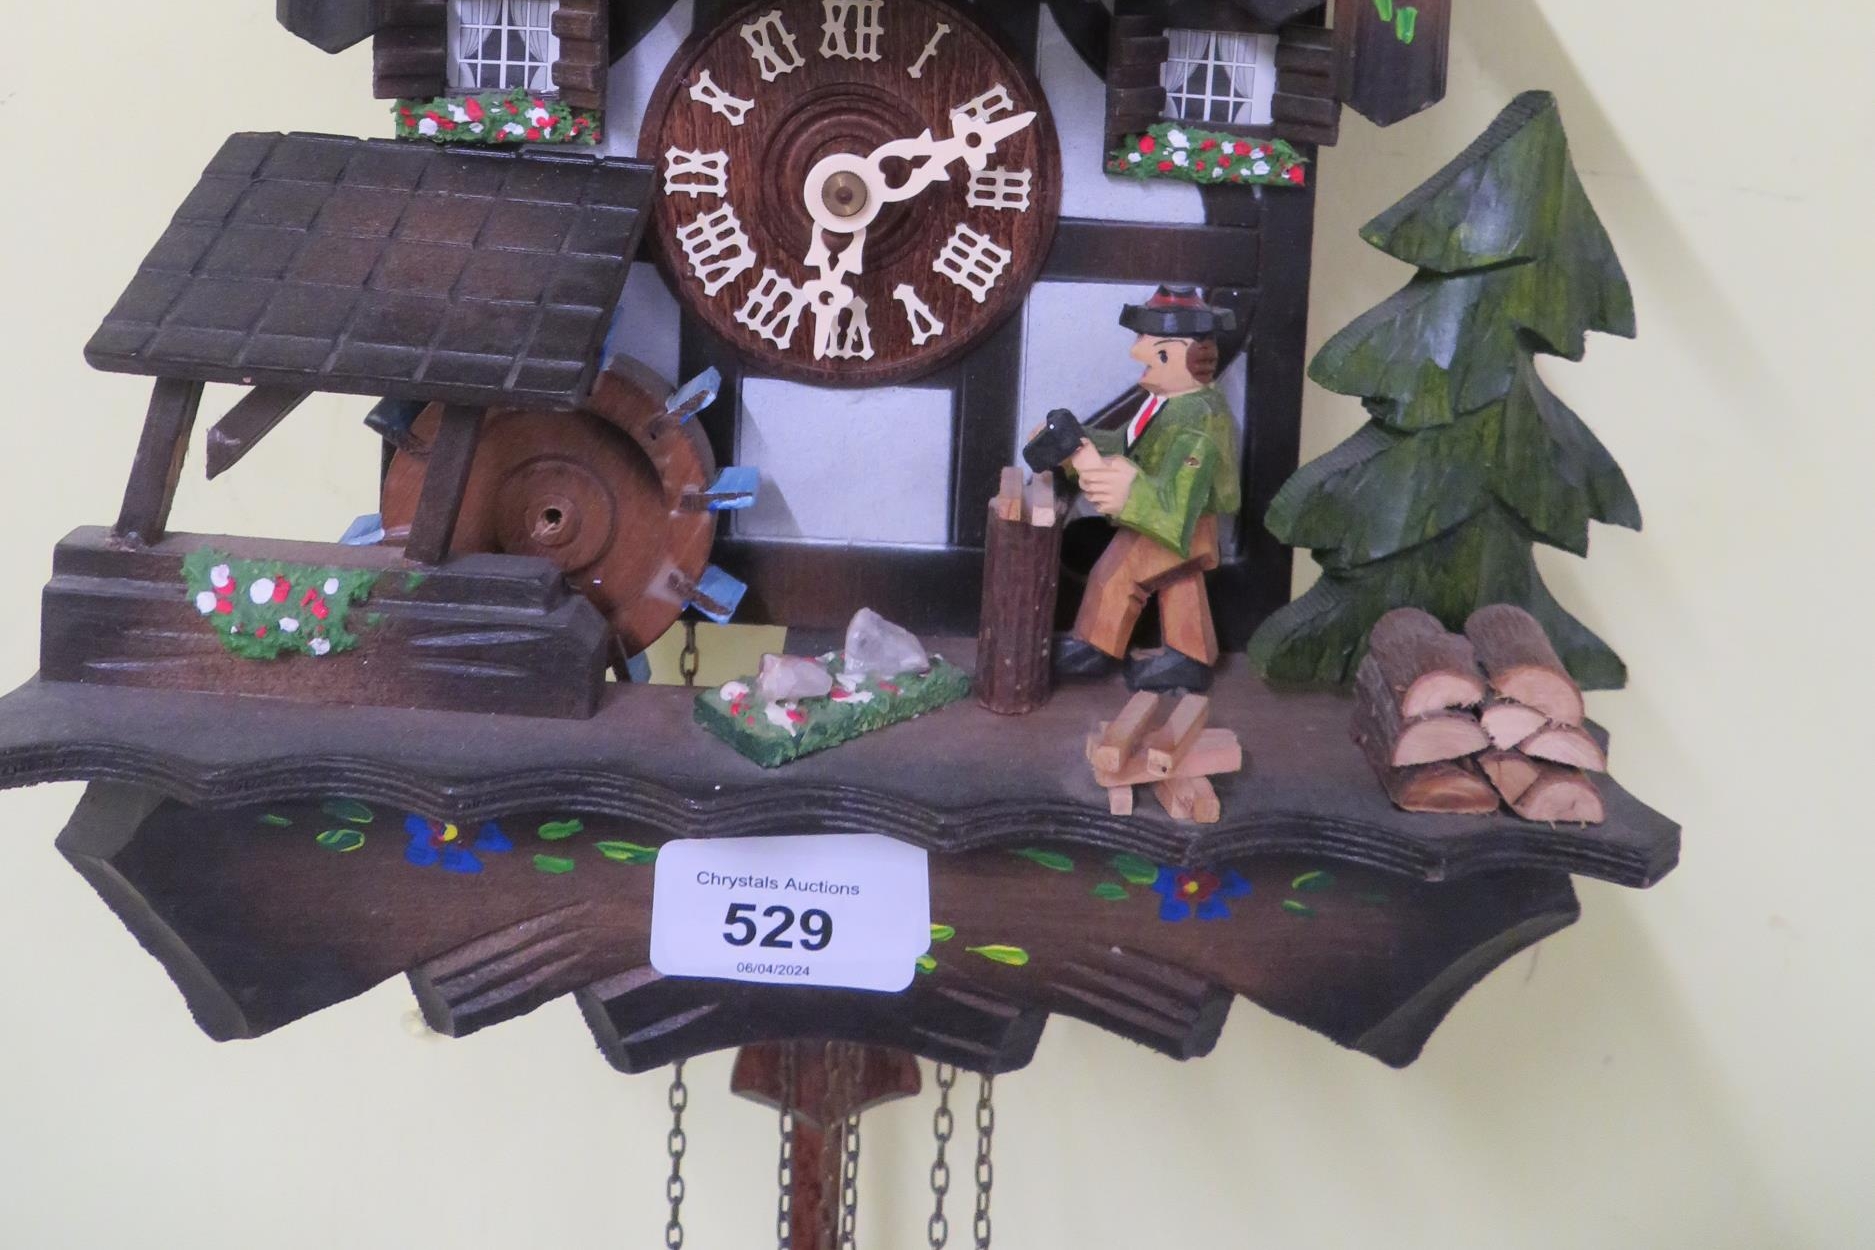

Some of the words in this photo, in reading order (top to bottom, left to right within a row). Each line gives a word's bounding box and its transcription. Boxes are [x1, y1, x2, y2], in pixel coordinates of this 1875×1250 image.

[696, 870, 779, 891] Chrystals
[784, 876, 860, 896] Auctions
[722, 902, 833, 951] 529
[736, 962, 810, 977] 06/04/2024
